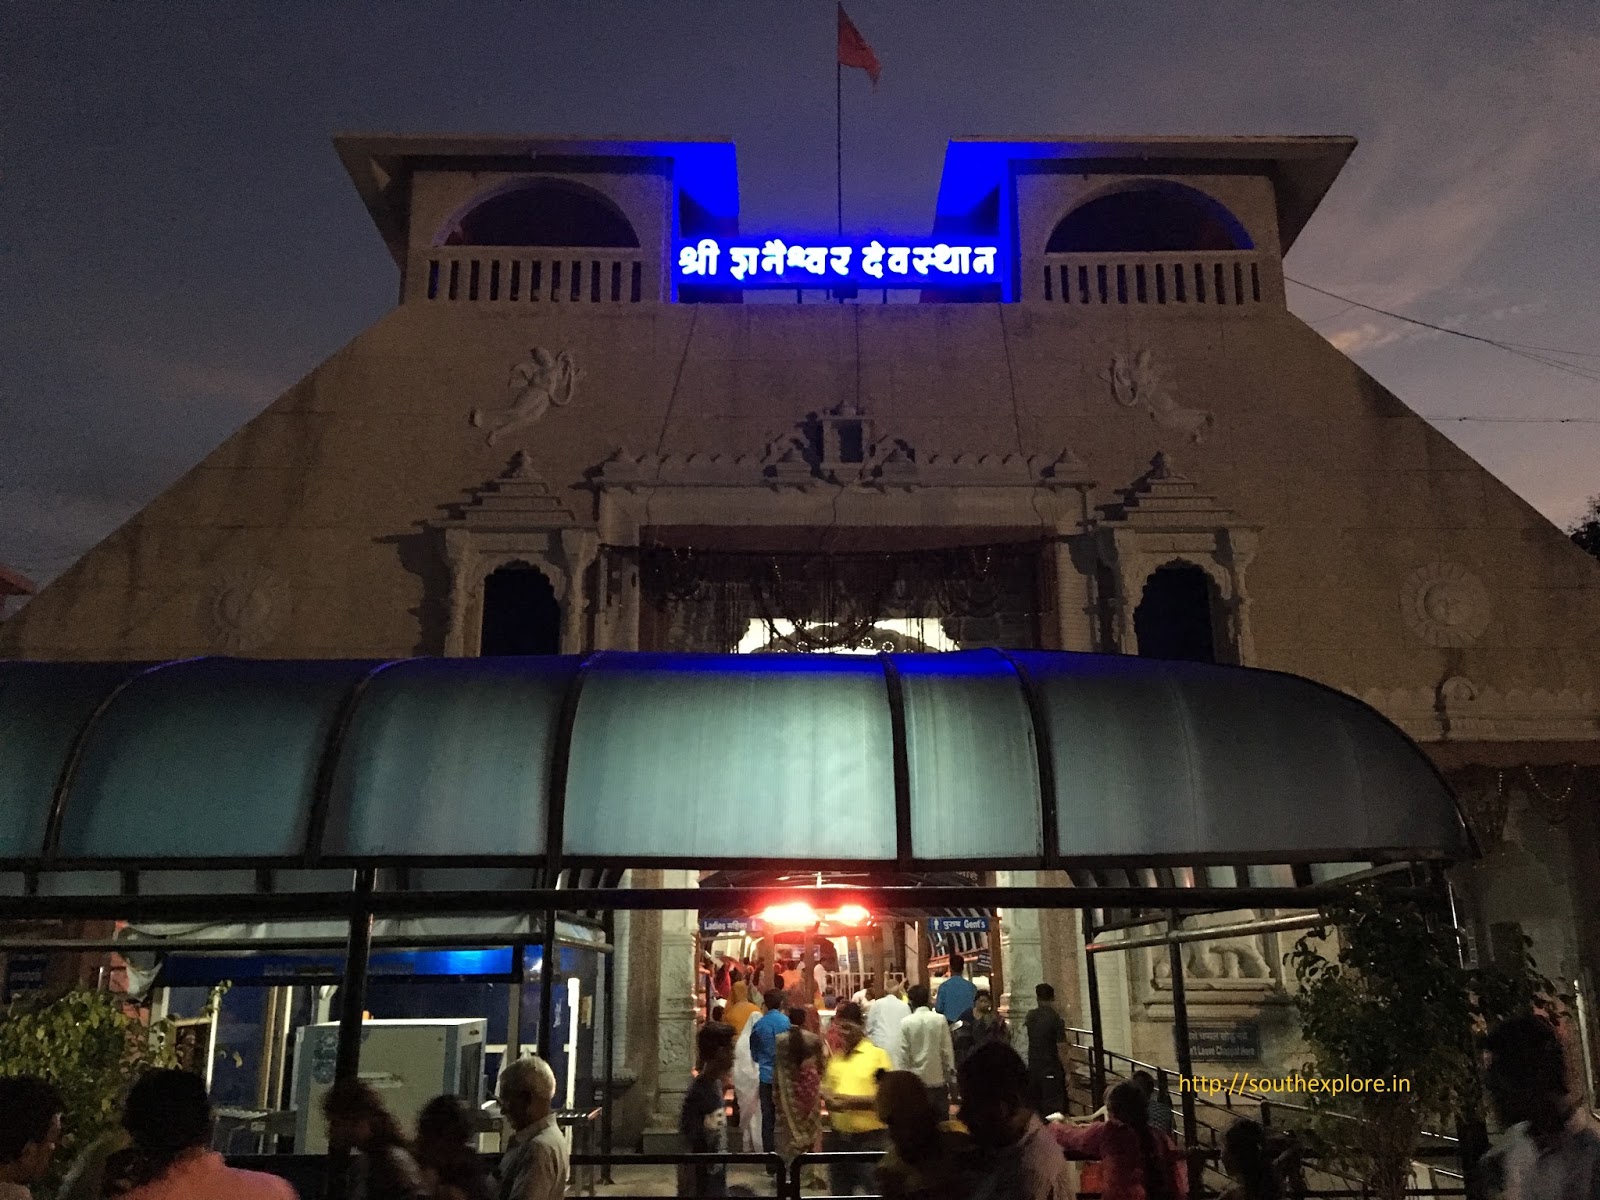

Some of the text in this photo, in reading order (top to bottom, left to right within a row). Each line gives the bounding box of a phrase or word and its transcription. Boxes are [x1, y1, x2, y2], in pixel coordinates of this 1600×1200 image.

[678, 238, 720, 275] श्री
[861, 240, 998, 278] देवस्थान
[703, 920, 726, 931] Ladies
[963, 919, 986, 929] Gent's
